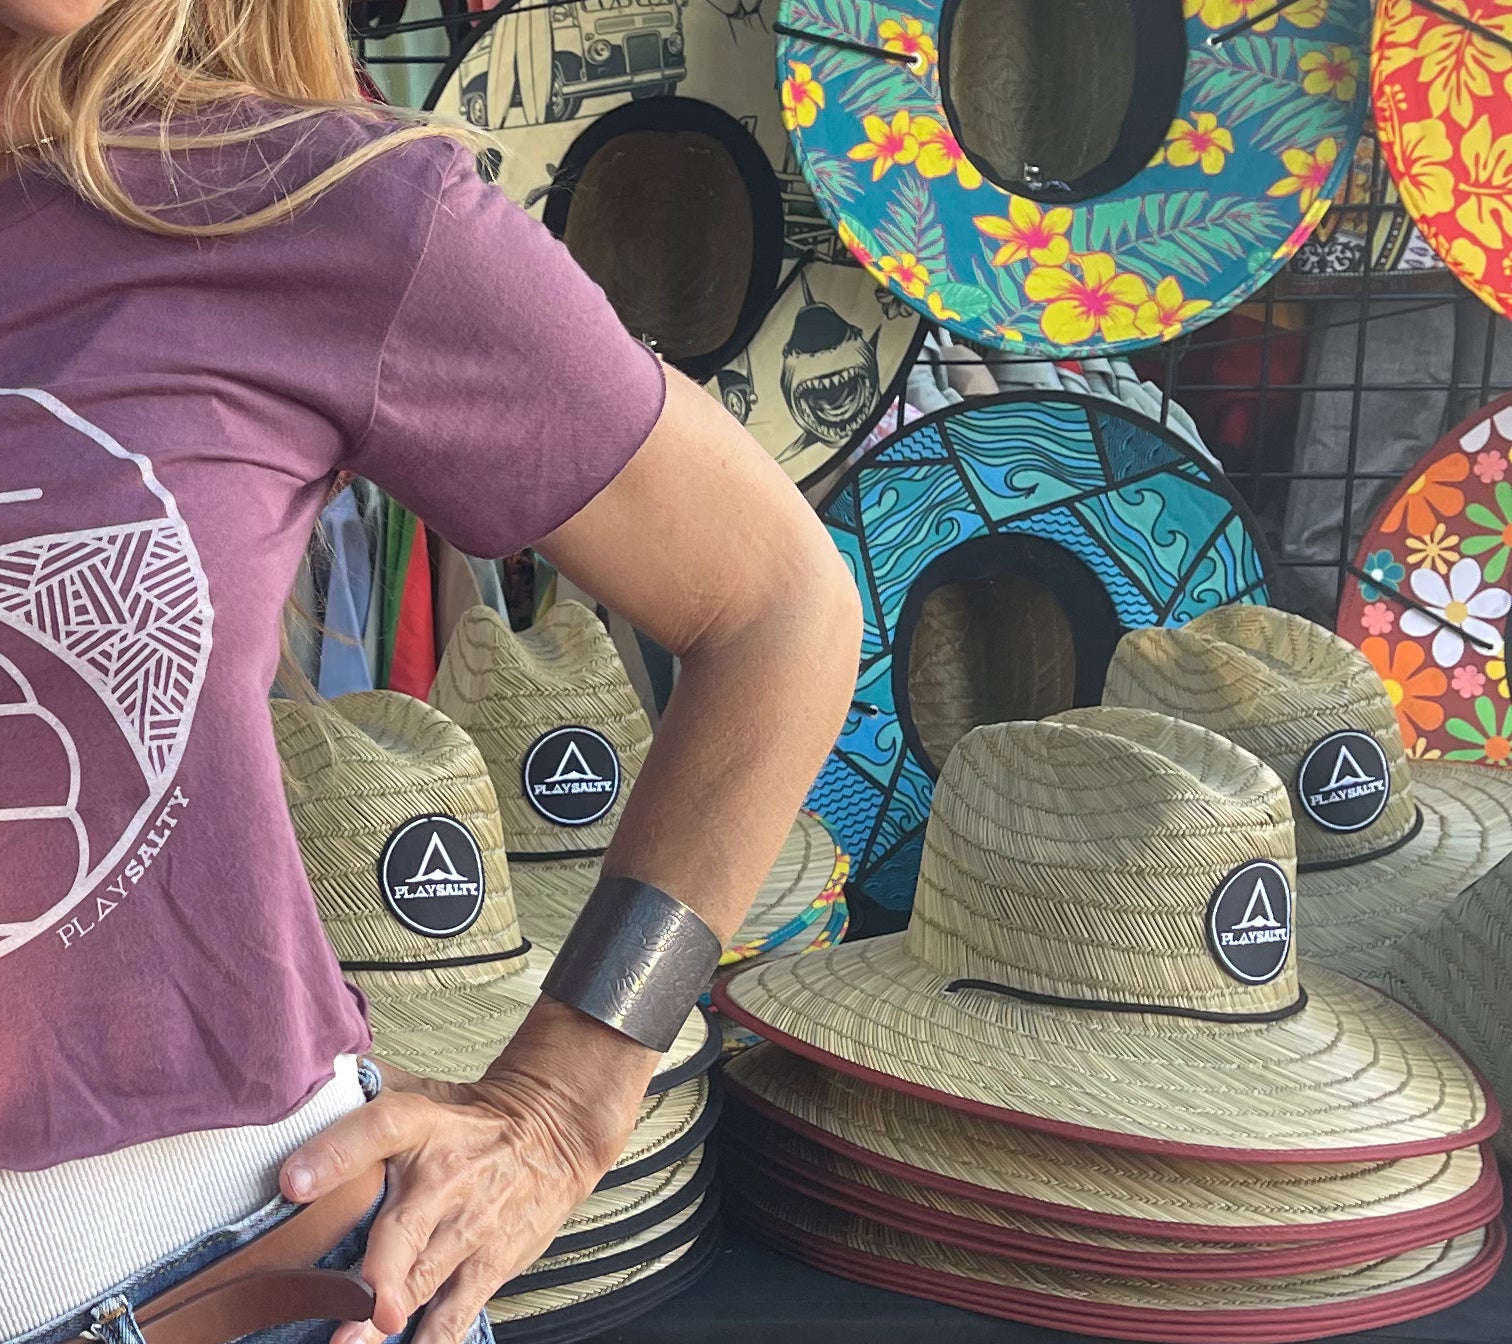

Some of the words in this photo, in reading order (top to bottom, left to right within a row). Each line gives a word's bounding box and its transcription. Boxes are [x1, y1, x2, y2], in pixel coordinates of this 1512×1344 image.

[534, 780, 613, 795] PLAYSALTY
[1309, 779, 1385, 807] PLAYSALTY
[55, 785, 191, 949] PLAYSALTY
[394, 882, 478, 899] PLAYSALTY
[1221, 928, 1288, 946] PLAYSALTY
